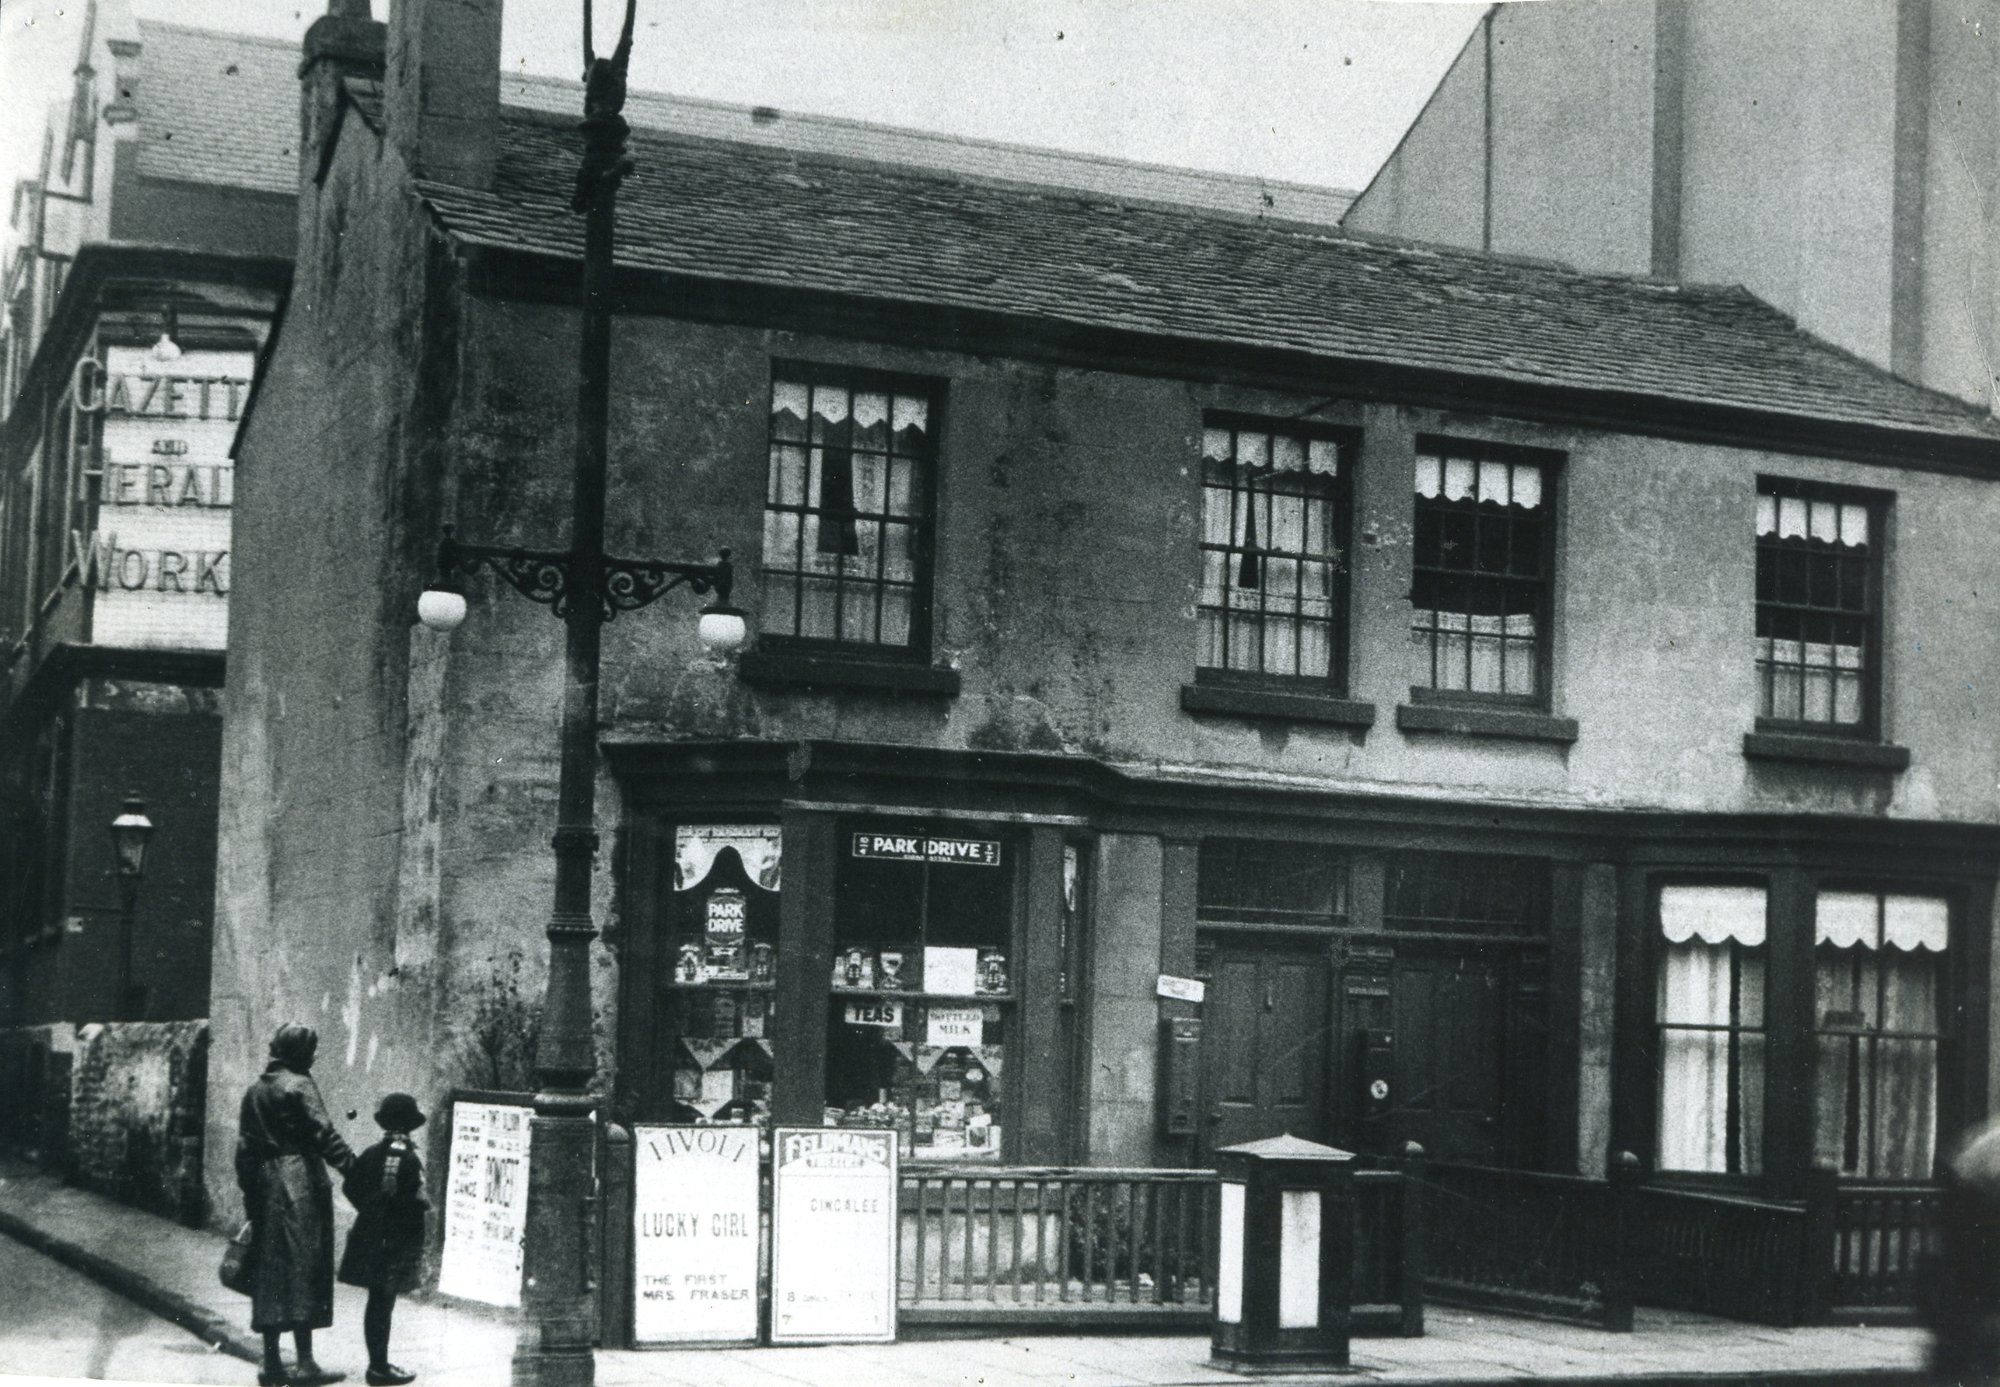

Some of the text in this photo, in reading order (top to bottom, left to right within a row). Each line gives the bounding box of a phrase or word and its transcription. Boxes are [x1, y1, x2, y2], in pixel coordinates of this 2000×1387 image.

[873, 836, 981, 858] PARK DRIVE
[708, 903, 744, 918] PARK
[708, 918, 744, 933] DRIVE
[855, 1006, 895, 1023] TEAS
[929, 1011, 981, 1022] BOTTLED
[939, 1024, 971, 1035] MILK
[647, 1129, 746, 1162] TIVOLI
[642, 1212, 749, 1238] LUCKY GIRL
[643, 1274, 727, 1286] THE FIRST
[642, 1288, 749, 1301] MRS FRASER
